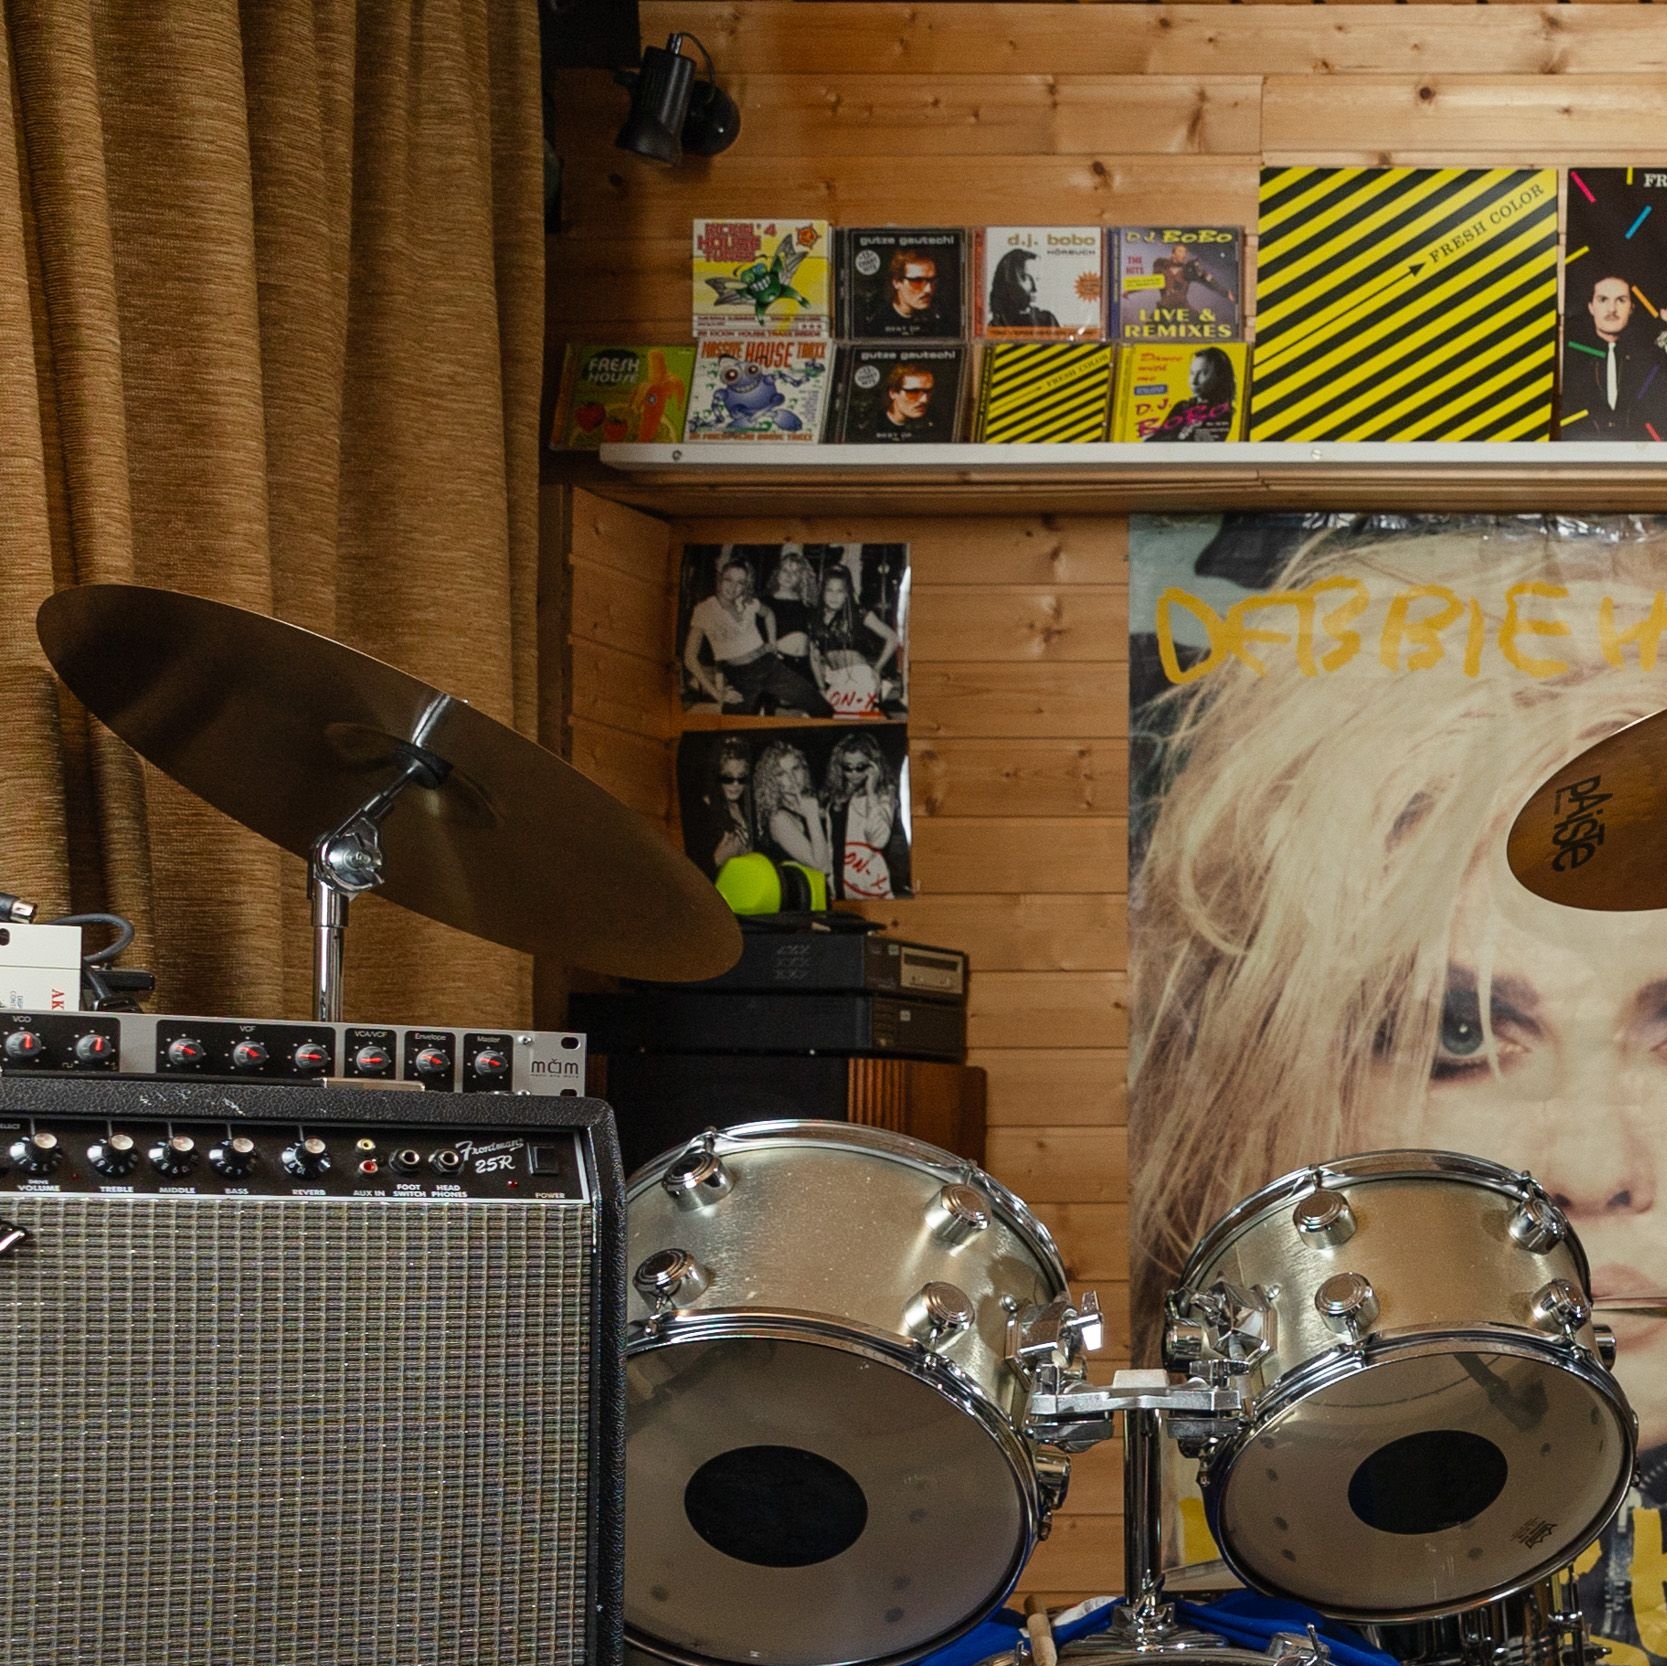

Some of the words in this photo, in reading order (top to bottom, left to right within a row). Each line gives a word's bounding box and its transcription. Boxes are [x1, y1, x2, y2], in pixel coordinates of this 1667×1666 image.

[1427, 216, 1486, 264] FRESH
[1488, 182, 1545, 225] COLOR
[860, 236, 895, 246] gutze
[899, 235, 954, 246] gautschi
[1007, 233, 1038, 247] d.j.
[1047, 233, 1096, 247] bobo
[1127, 257, 1142, 265] THE
[1126, 267, 1144, 275] HITS
[1139, 308, 1189, 322] LIVE
[1199, 308, 1216, 322] &
[1124, 323, 1231, 338] REMIXES
[861, 351, 897, 361] gutze
[900, 350, 956, 361] gautschi
[1140, 352, 1183, 363] Dance
[588, 357, 640, 372] FRESH
[589, 372, 638, 383] HOUSE
[1046, 369, 1076, 389] FRESH
[1156, 576, 1574, 685] DEBBIE
[830, 690, 879, 710] ON-X
[844, 852, 889, 891] ON-X
[12, 1015, 32, 1023] VCO
[240, 1025, 256, 1033] VCF
[415, 1033, 447, 1042] Envelope
[477, 1035, 500, 1043] Master
[456, 1138, 525, 1161] Frontman
[475, 1155, 516, 1173] 25R
[392, 1190, 427, 1198] SWITCH
[431, 1191, 468, 1199] PHONES
